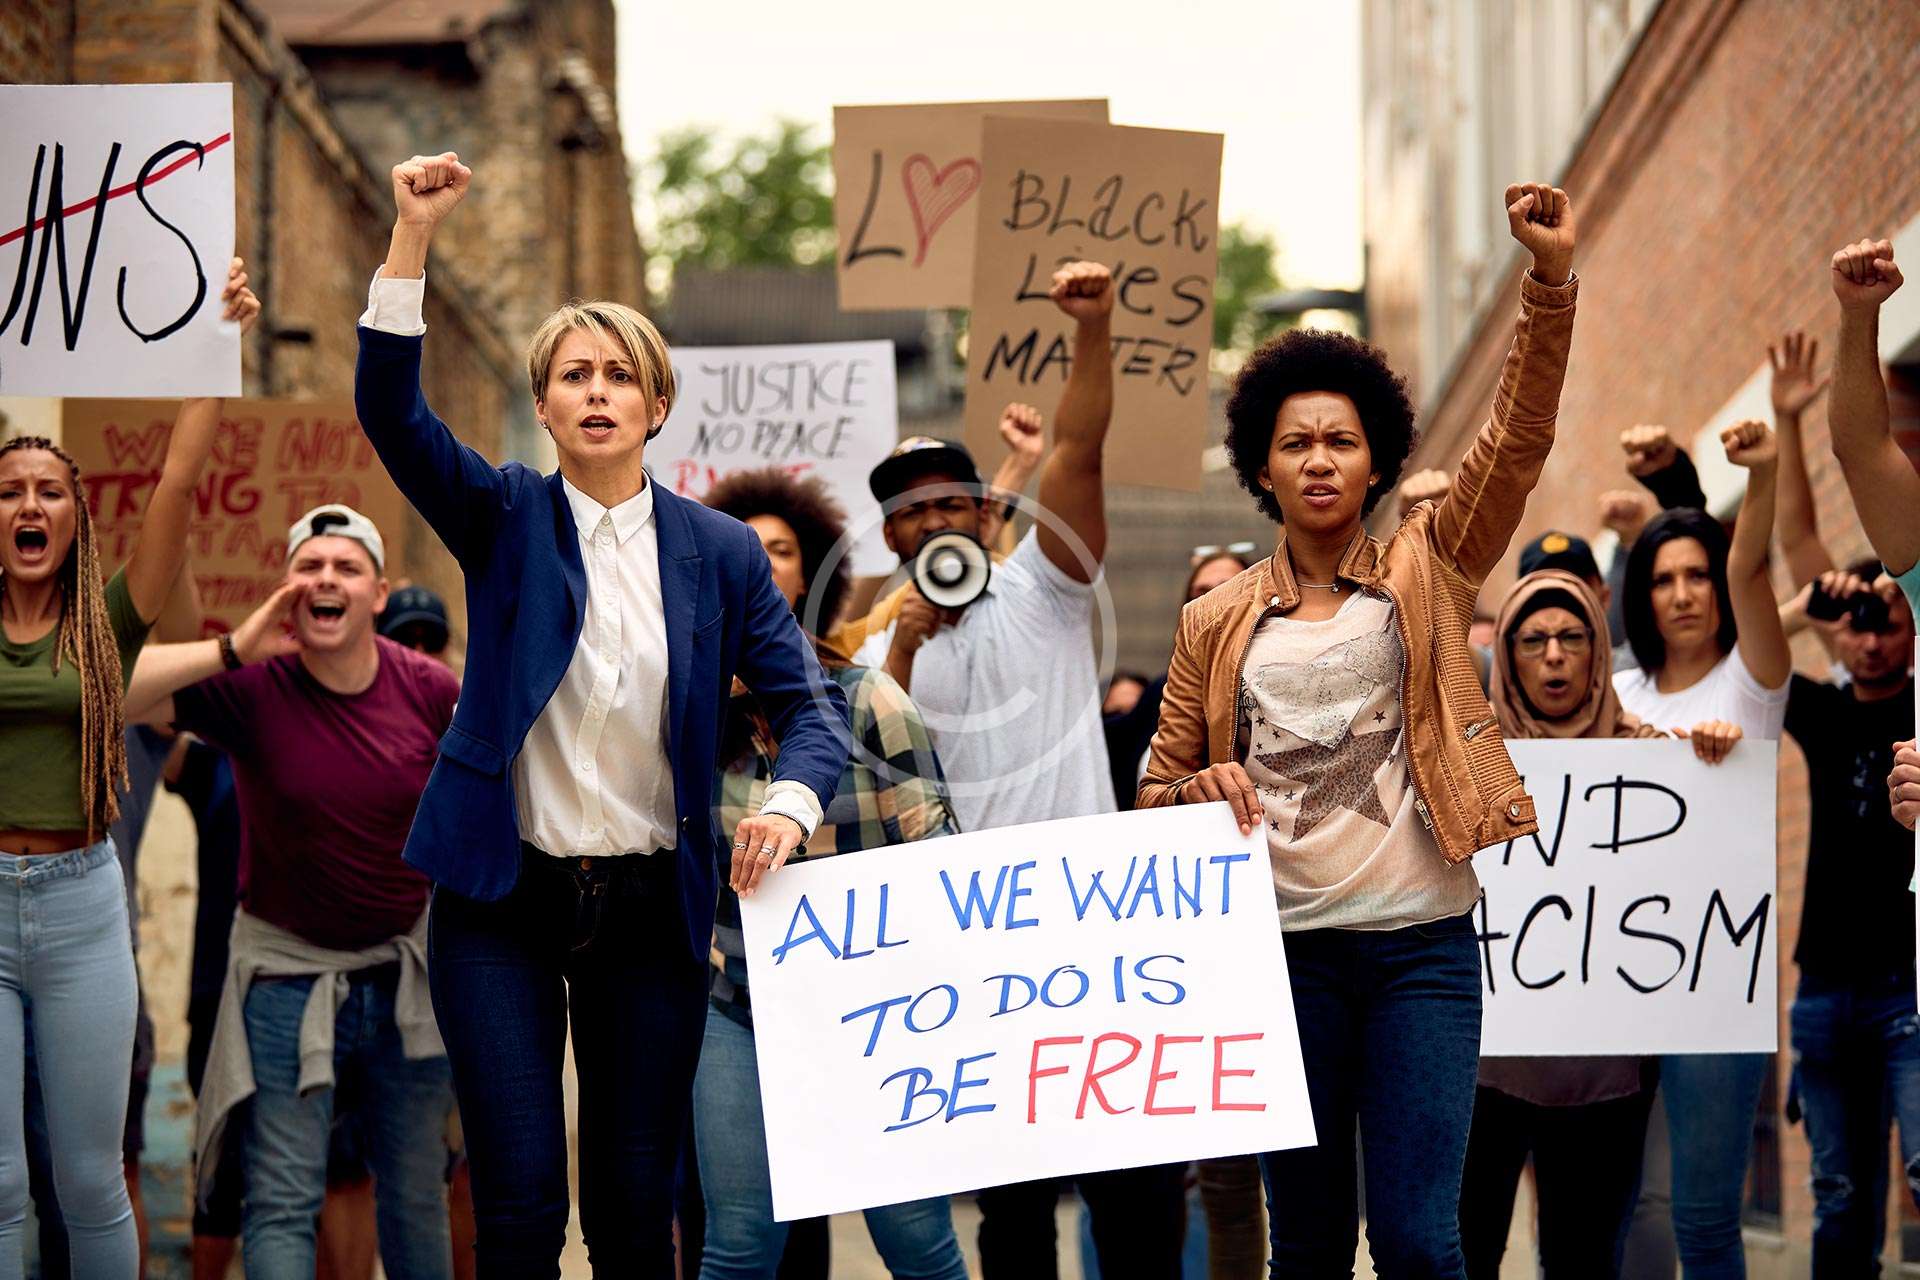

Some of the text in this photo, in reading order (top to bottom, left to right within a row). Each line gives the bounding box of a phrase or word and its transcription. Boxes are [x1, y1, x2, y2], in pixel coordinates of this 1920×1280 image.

[699, 358, 874, 418] JUSTICE
[982, 327, 1198, 397] MATER
[686, 421, 746, 459] NO
[1502, 773, 1687, 867] ND
[772, 852, 1251, 966] ALL WE WANT
[1470, 885, 1772, 1004] ACISM
[841, 954, 1187, 1057] TO DO IS
[880, 1032, 1267, 1132] BE FREE
